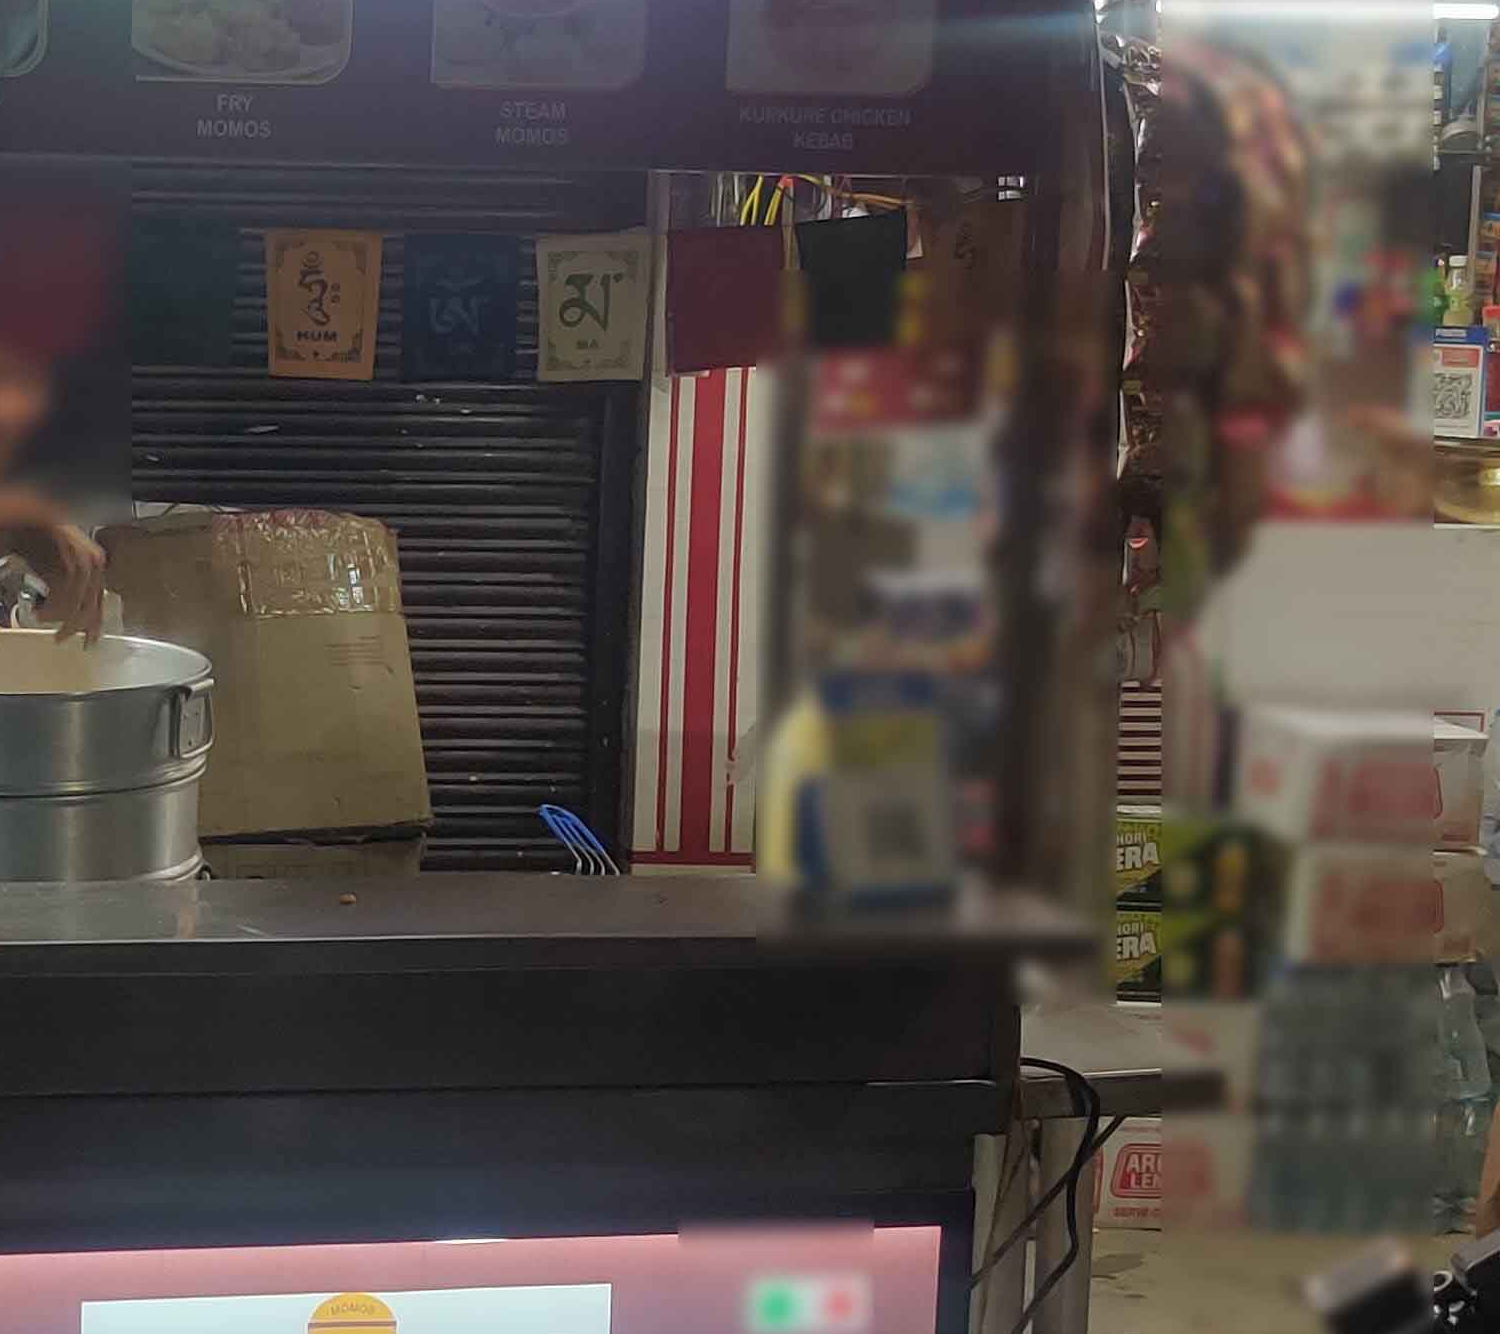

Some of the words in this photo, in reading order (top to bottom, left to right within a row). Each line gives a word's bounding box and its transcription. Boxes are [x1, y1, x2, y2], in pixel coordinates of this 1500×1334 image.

[216, 94, 253, 113] FRY
[500, 100, 567, 120] STEAM
[196, 119, 272, 139] MOMOS
